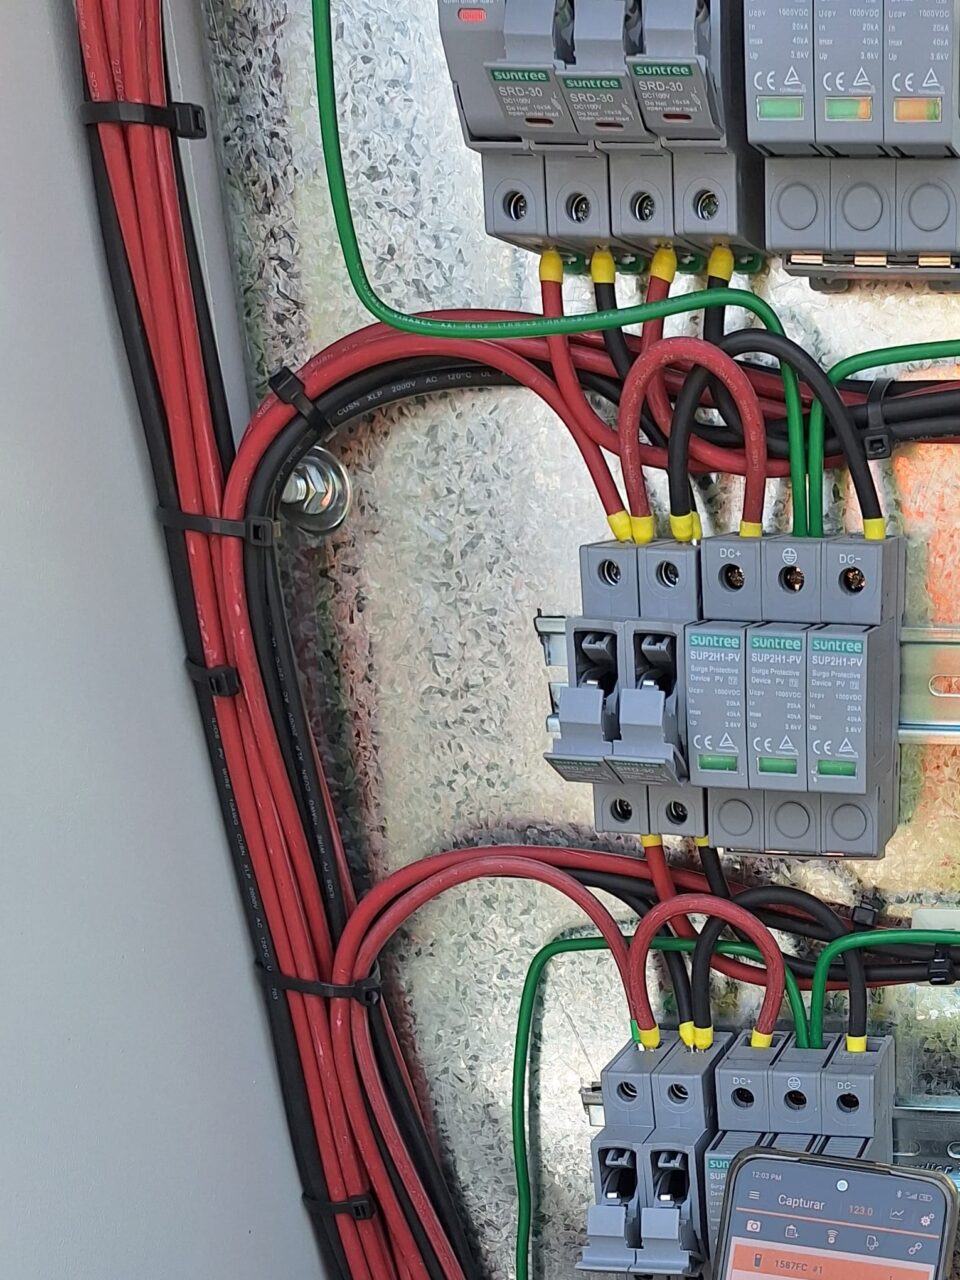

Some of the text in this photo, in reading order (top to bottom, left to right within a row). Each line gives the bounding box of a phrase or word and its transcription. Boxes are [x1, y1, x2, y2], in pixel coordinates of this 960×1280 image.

[494, 70, 547, 82] suntree
[635, 65, 690, 76] suntree
[566, 79, 619, 89] suntree
[638, 81, 683, 92] SRD-30
[499, 86, 542, 97] SRD-30
[570, 93, 613, 103] SRD-30
[367, 391, 383, 402] XLP
[391, 380, 416, 393] 2000V
[425, 375, 438, 384] AC
[719, 548, 741, 559] DC+
[691, 636, 739, 648] suntree
[752, 637, 801, 650] suntree
[813, 640, 862, 652] suntree
[690, 651, 741, 662] SUP2H1-PV
[752, 653, 802, 664] SUP2H1-PV
[812, 656, 863, 666] SUP2H1-PV
[733, 1077, 752, 1085] DC+
[752, 1171, 782, 1181] 12:03 PM
[778, 1194, 825, 1211] Capturar
[849, 1205, 873, 1216] 123.0
[775, 1259, 823, 1274] 1587FC #1
